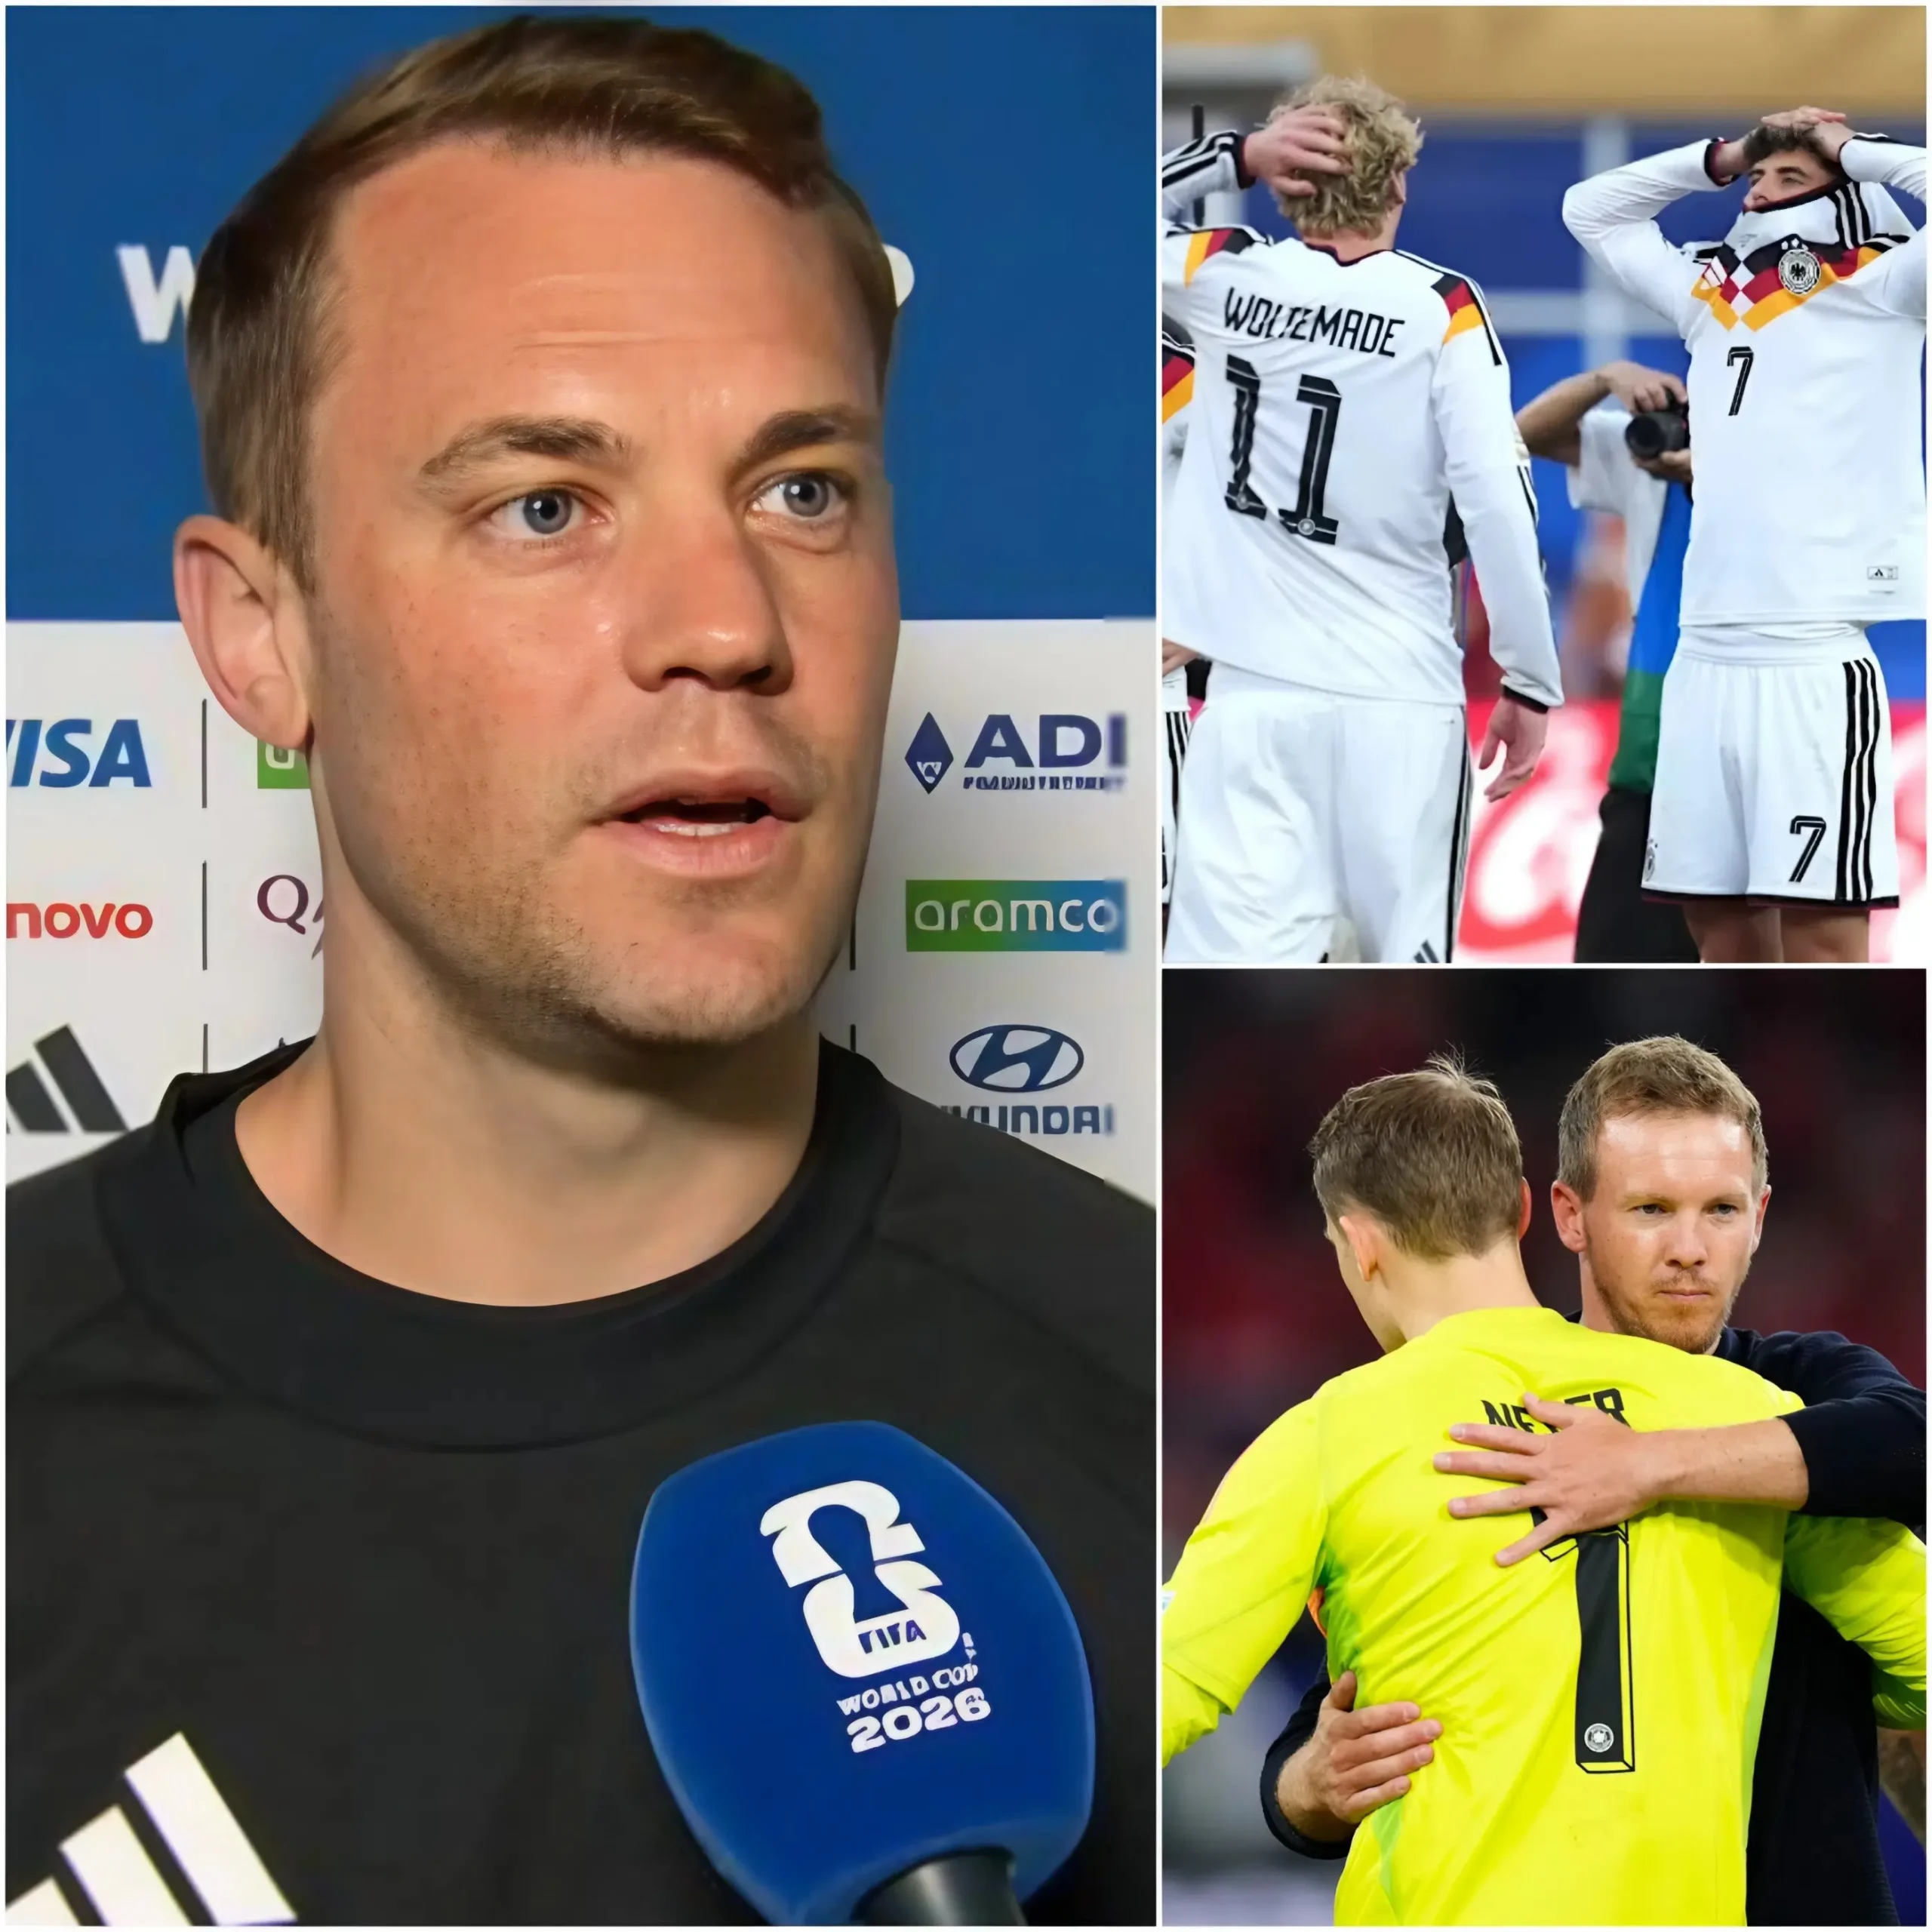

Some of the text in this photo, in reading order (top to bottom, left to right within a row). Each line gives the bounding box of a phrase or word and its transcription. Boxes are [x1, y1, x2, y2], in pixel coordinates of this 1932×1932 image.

[1225, 286, 1406, 358] WOLTEMADE
[1727, 346, 1754, 416] 7
[1224, 353, 1342, 546] 11
[964, 714, 1127, 768] ADI
[1789, 816, 1826, 883] 7
[914, 899, 1118, 933] aramco
[1480, 1387, 1632, 1435] NER
[1526, 1498, 1635, 1774] 1
[847, 1687, 992, 1753] 2026
